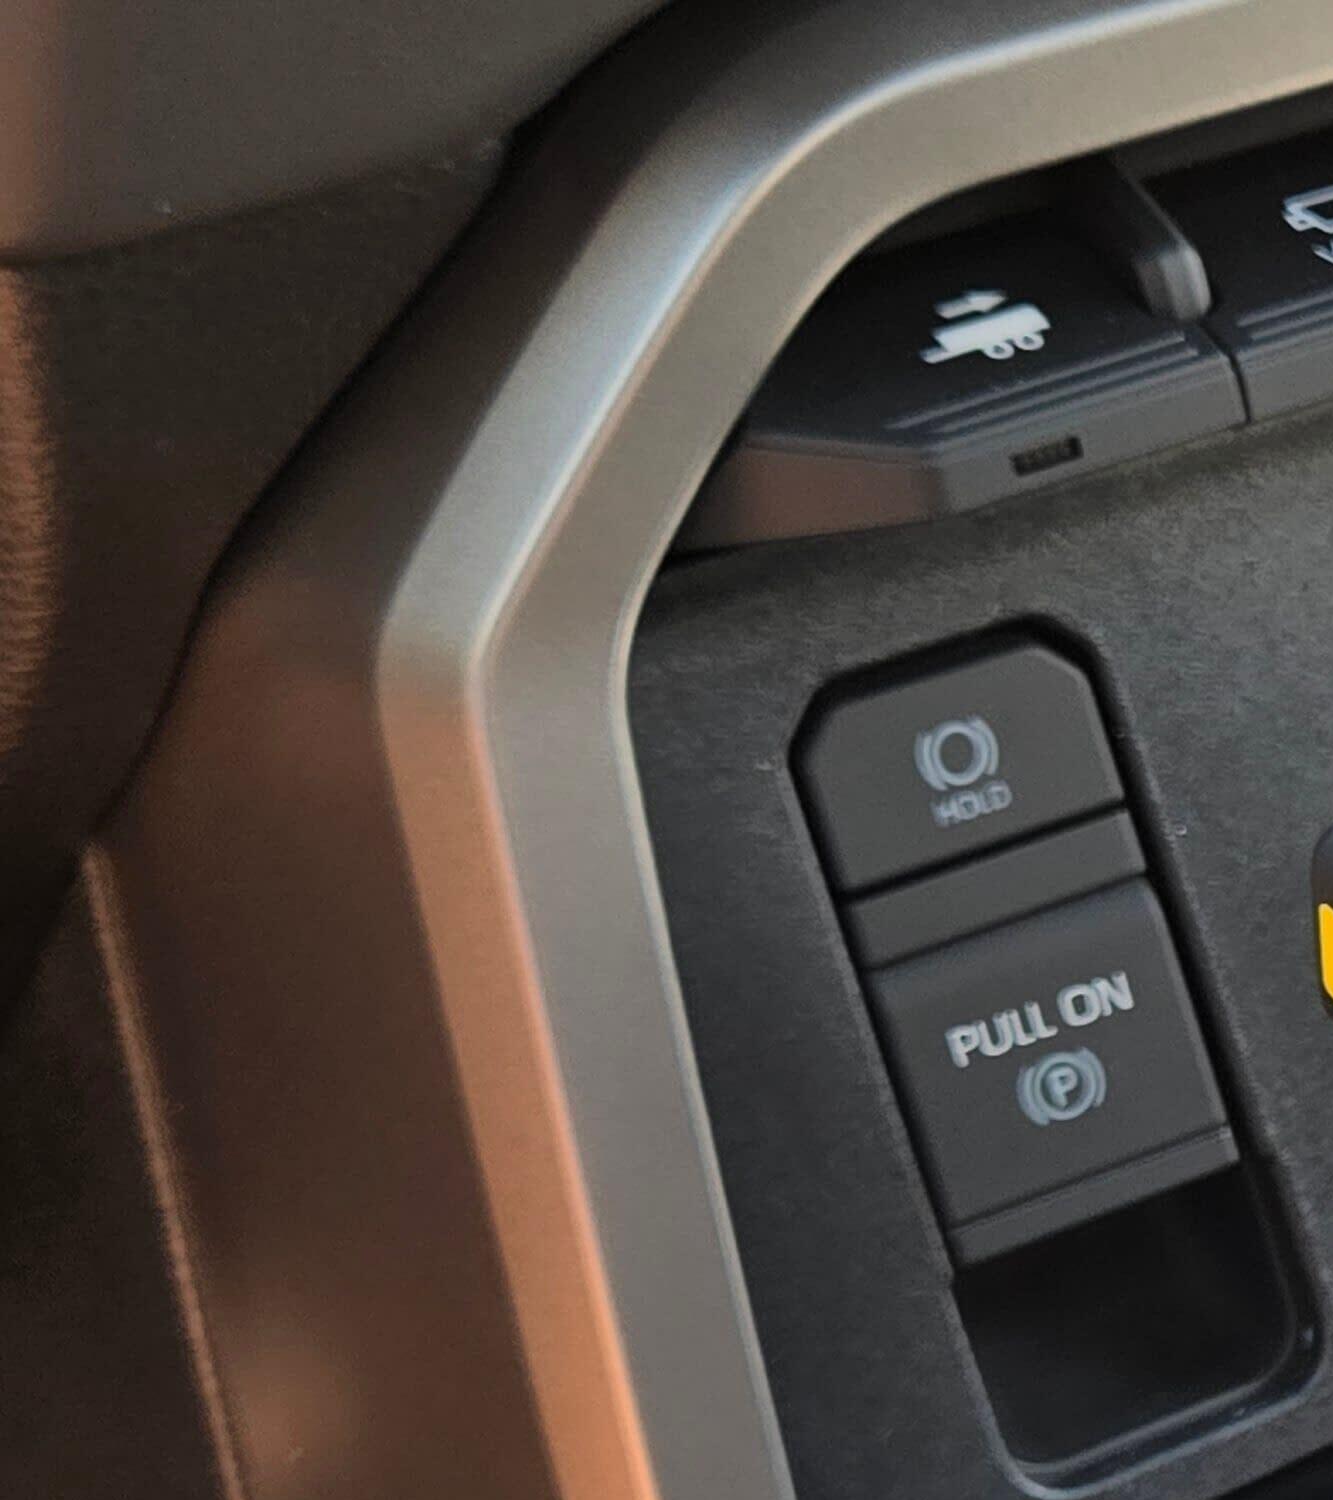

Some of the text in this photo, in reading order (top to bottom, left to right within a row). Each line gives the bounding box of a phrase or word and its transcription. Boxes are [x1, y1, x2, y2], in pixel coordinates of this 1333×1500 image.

[931, 780, 1012, 828] HOLD
[945, 970, 1134, 1068] PULL ON
